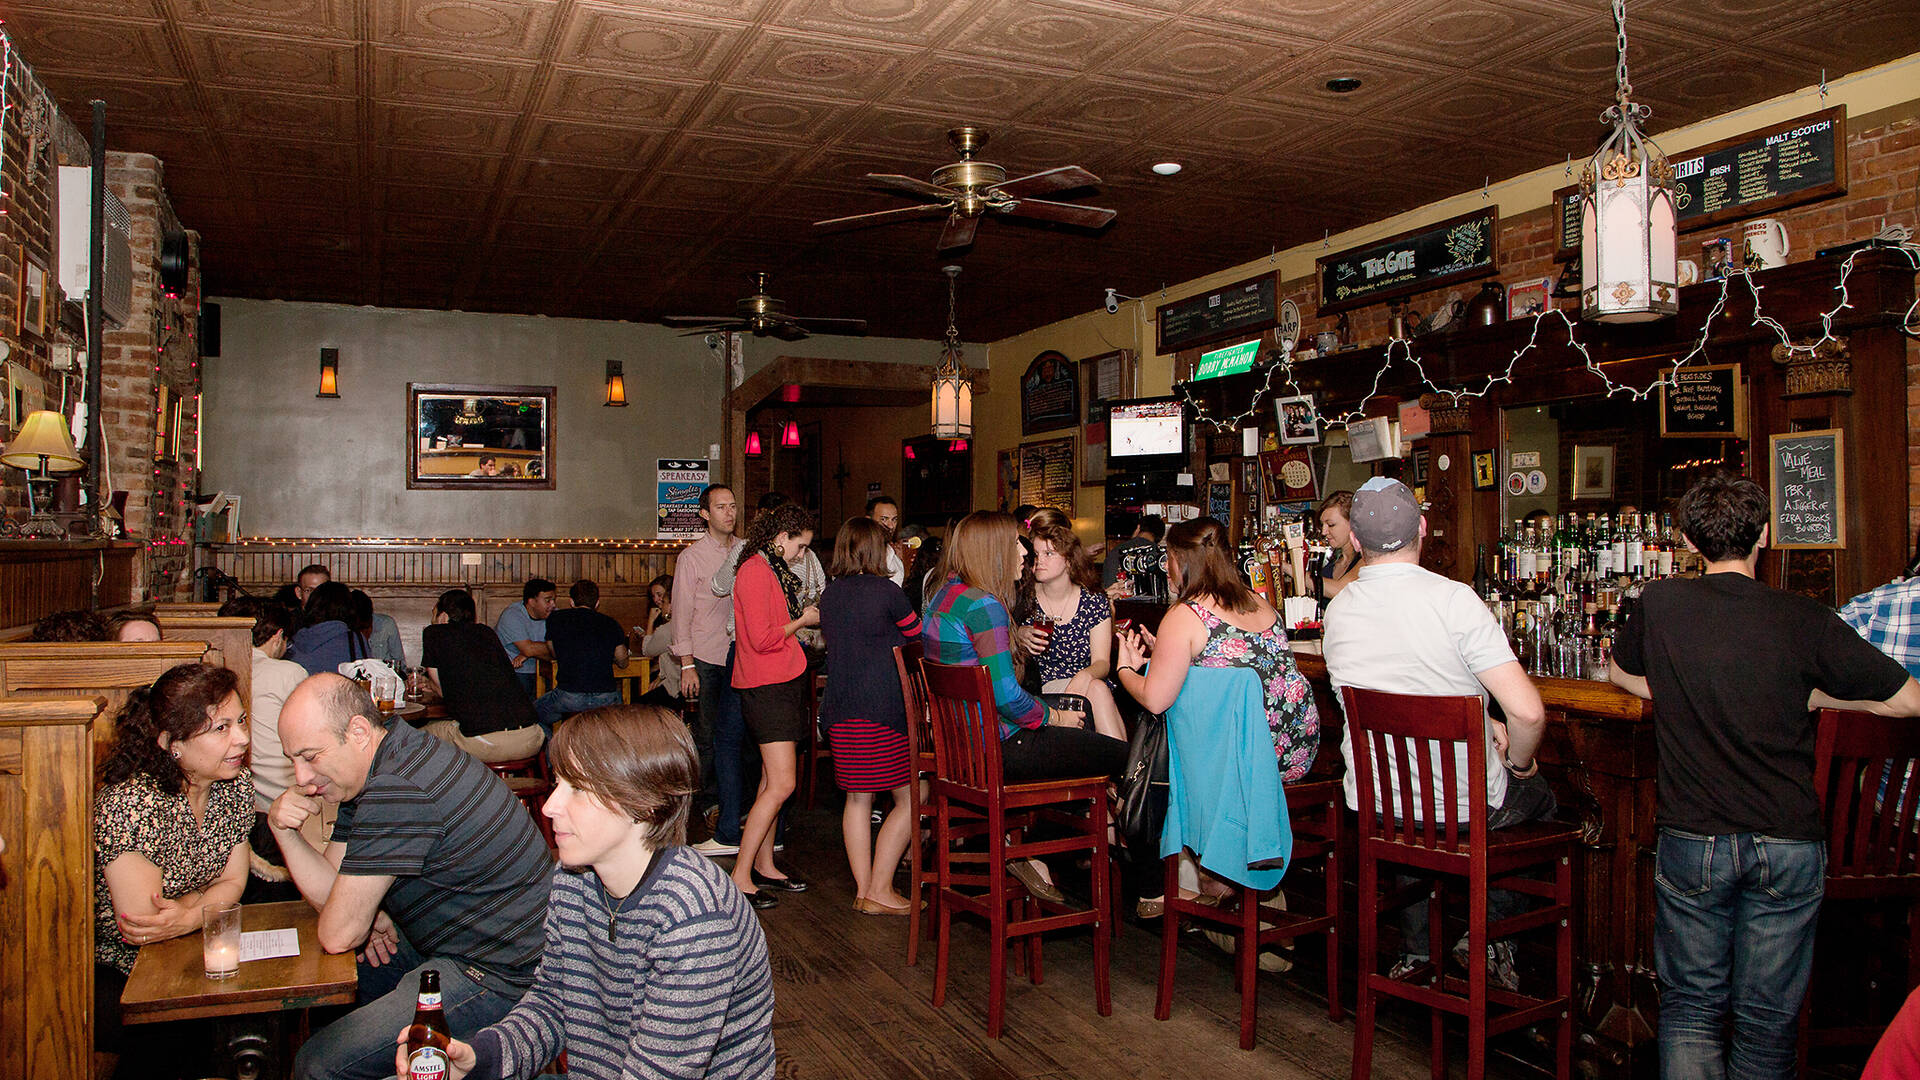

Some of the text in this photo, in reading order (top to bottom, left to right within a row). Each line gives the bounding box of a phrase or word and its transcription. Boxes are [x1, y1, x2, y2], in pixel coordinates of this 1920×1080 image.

[1766, 132, 1790, 146] MALT
[1791, 120, 1830, 139] SCOTCH
[1675, 158, 1704, 178] IRITS
[1710, 164, 1731, 177] IRISH
[1361, 257, 1386, 279] THE
[1385, 250, 1416, 274] GATE
[1278, 321, 1297, 335] HARP
[1781, 452, 1812, 468] VALUE
[661, 471, 706, 481] SPEAKEASY
[1800, 465, 1825, 480] MEAL
[1784, 484, 1805, 497] PBR
[1784, 500, 1792, 511] A
[1792, 499, 1819, 512] JIGGER
[1780, 512, 1831, 524] EZRA BROOKS
[1793, 521, 1832, 534] BOURBON
[414, 1064, 441, 1073] AMSTEL
